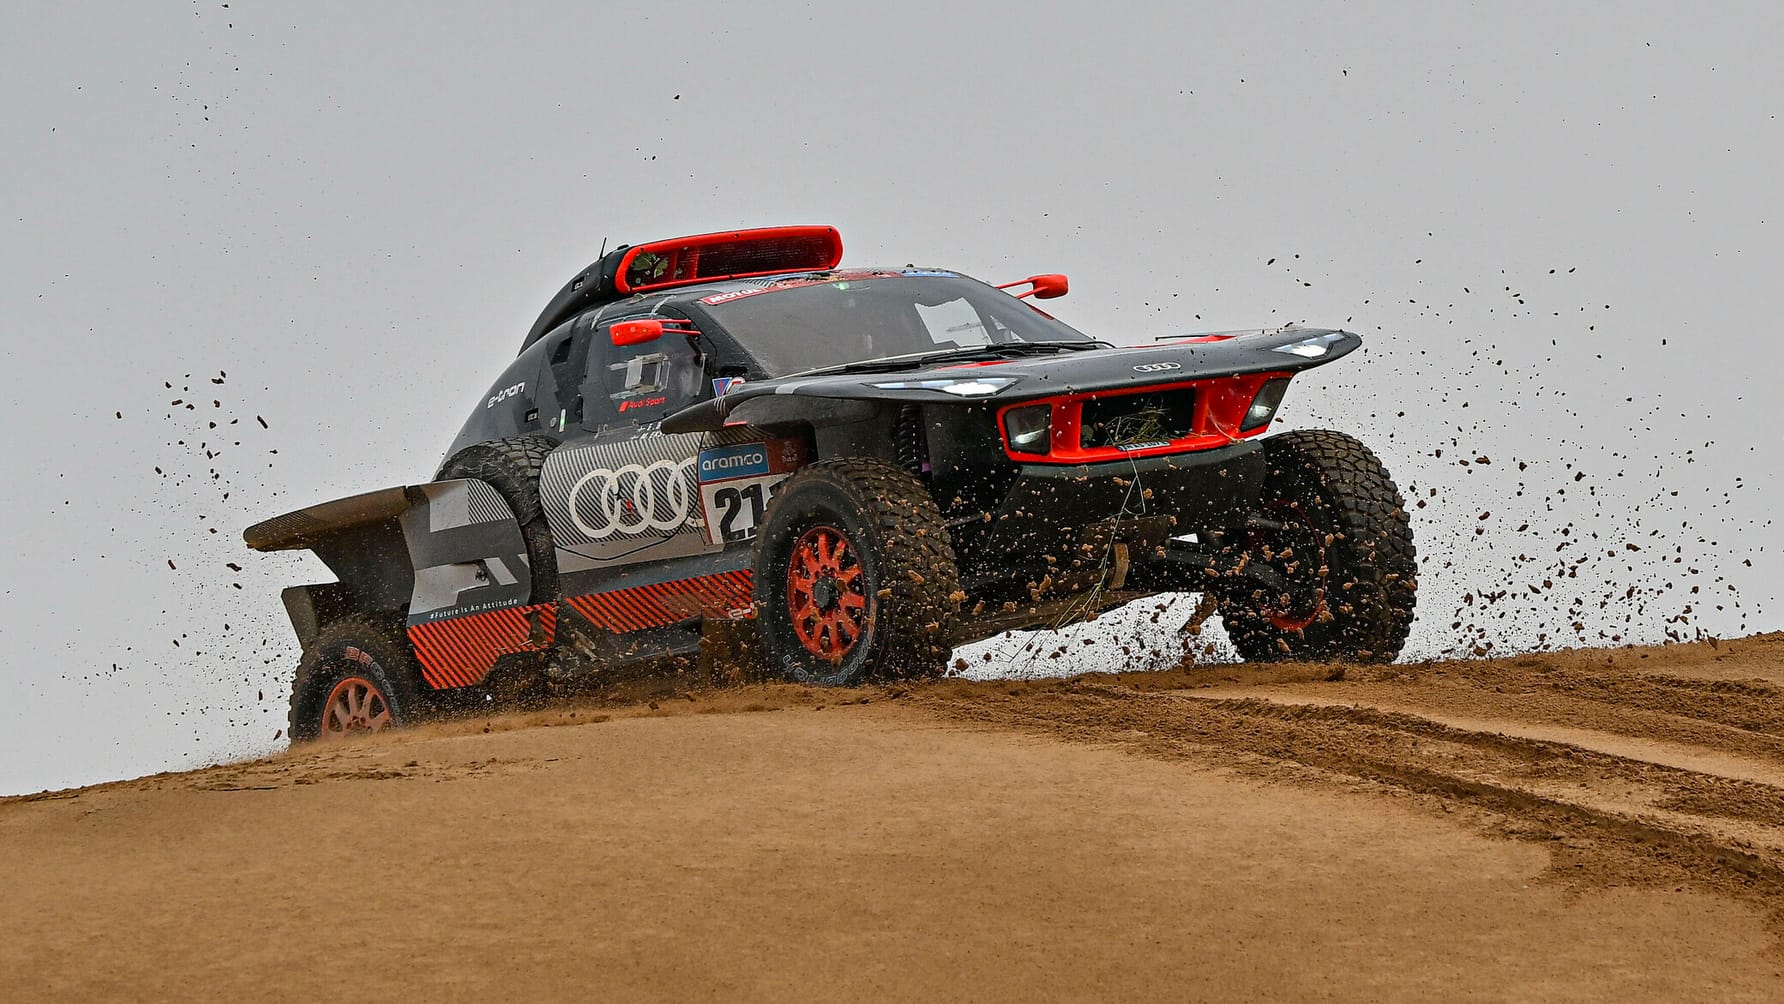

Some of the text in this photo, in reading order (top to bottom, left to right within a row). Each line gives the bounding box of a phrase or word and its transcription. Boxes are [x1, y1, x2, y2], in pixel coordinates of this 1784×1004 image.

[709, 286, 764, 303] MOTUL
[487, 381, 525, 408] e-tron
[629, 396, 666, 408] Audi Sport
[702, 453, 763, 471] aramco
[714, 483, 783, 543] 21
[430, 609, 459, 619] #Future
[482, 598, 518, 610] Attitude
